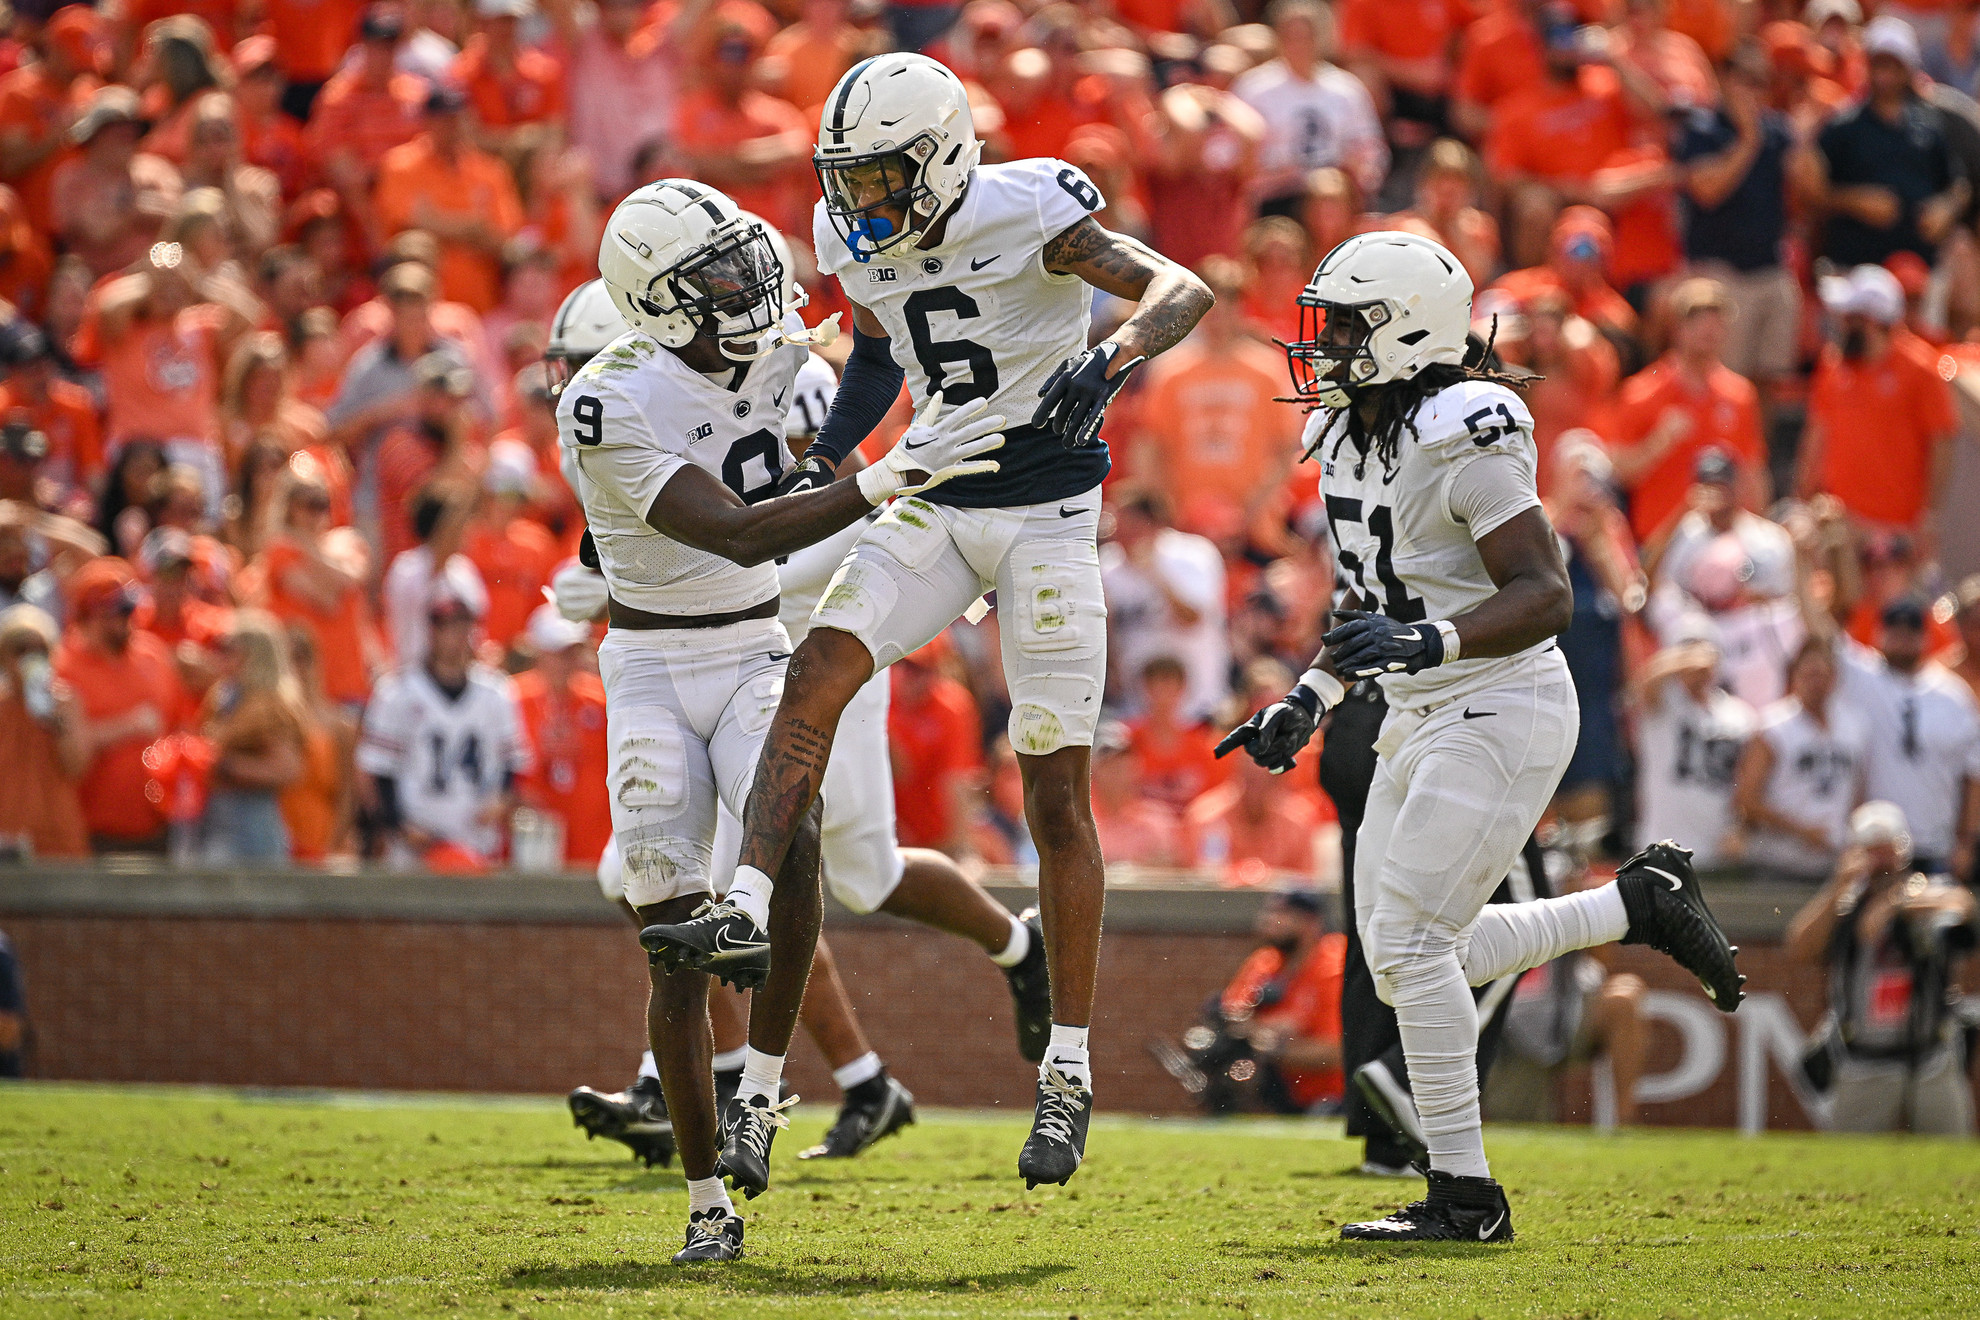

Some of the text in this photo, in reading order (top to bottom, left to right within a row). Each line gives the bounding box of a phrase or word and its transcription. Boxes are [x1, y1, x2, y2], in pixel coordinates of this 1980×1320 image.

[1056, 169, 1099, 211] 6
[903, 285, 999, 406] 6
[573, 395, 603, 446] 9
[1463, 403, 1519, 447] 51
[1325, 493, 1427, 624] 51
[430, 731, 485, 796] 14
